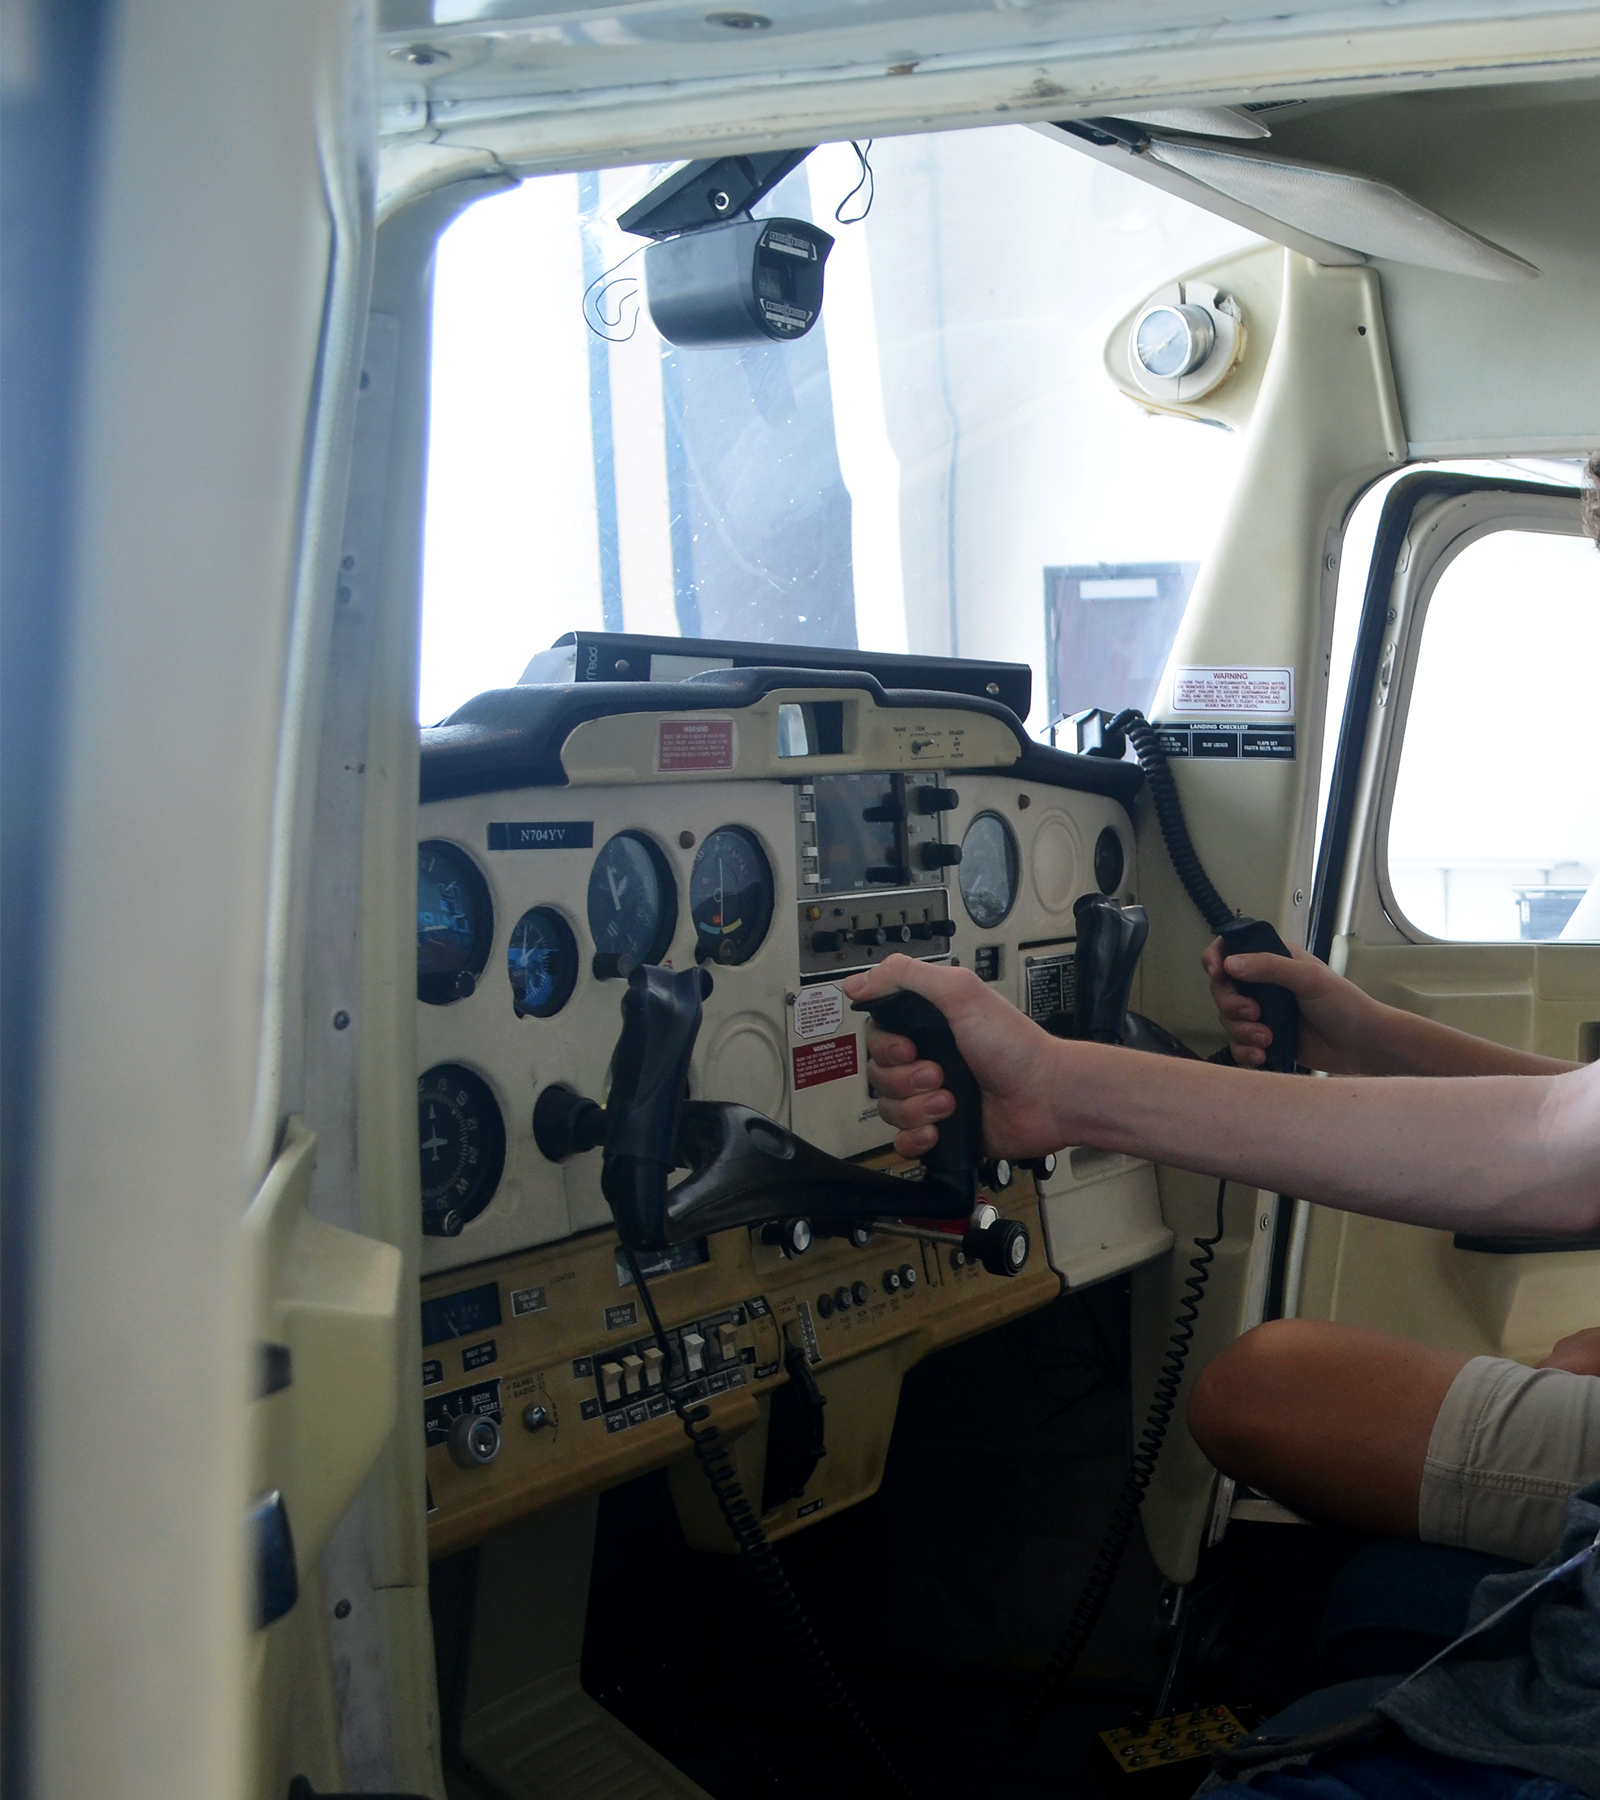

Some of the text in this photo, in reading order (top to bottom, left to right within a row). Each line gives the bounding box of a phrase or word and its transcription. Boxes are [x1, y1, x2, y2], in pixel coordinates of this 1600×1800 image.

[1213, 672, 1248, 680] WARNING
[521, 829, 566, 842] N704YV
[471, 1391, 491, 1403] BOTH
[479, 1401, 499, 1413] START
[426, 1418, 440, 1430] OFF
